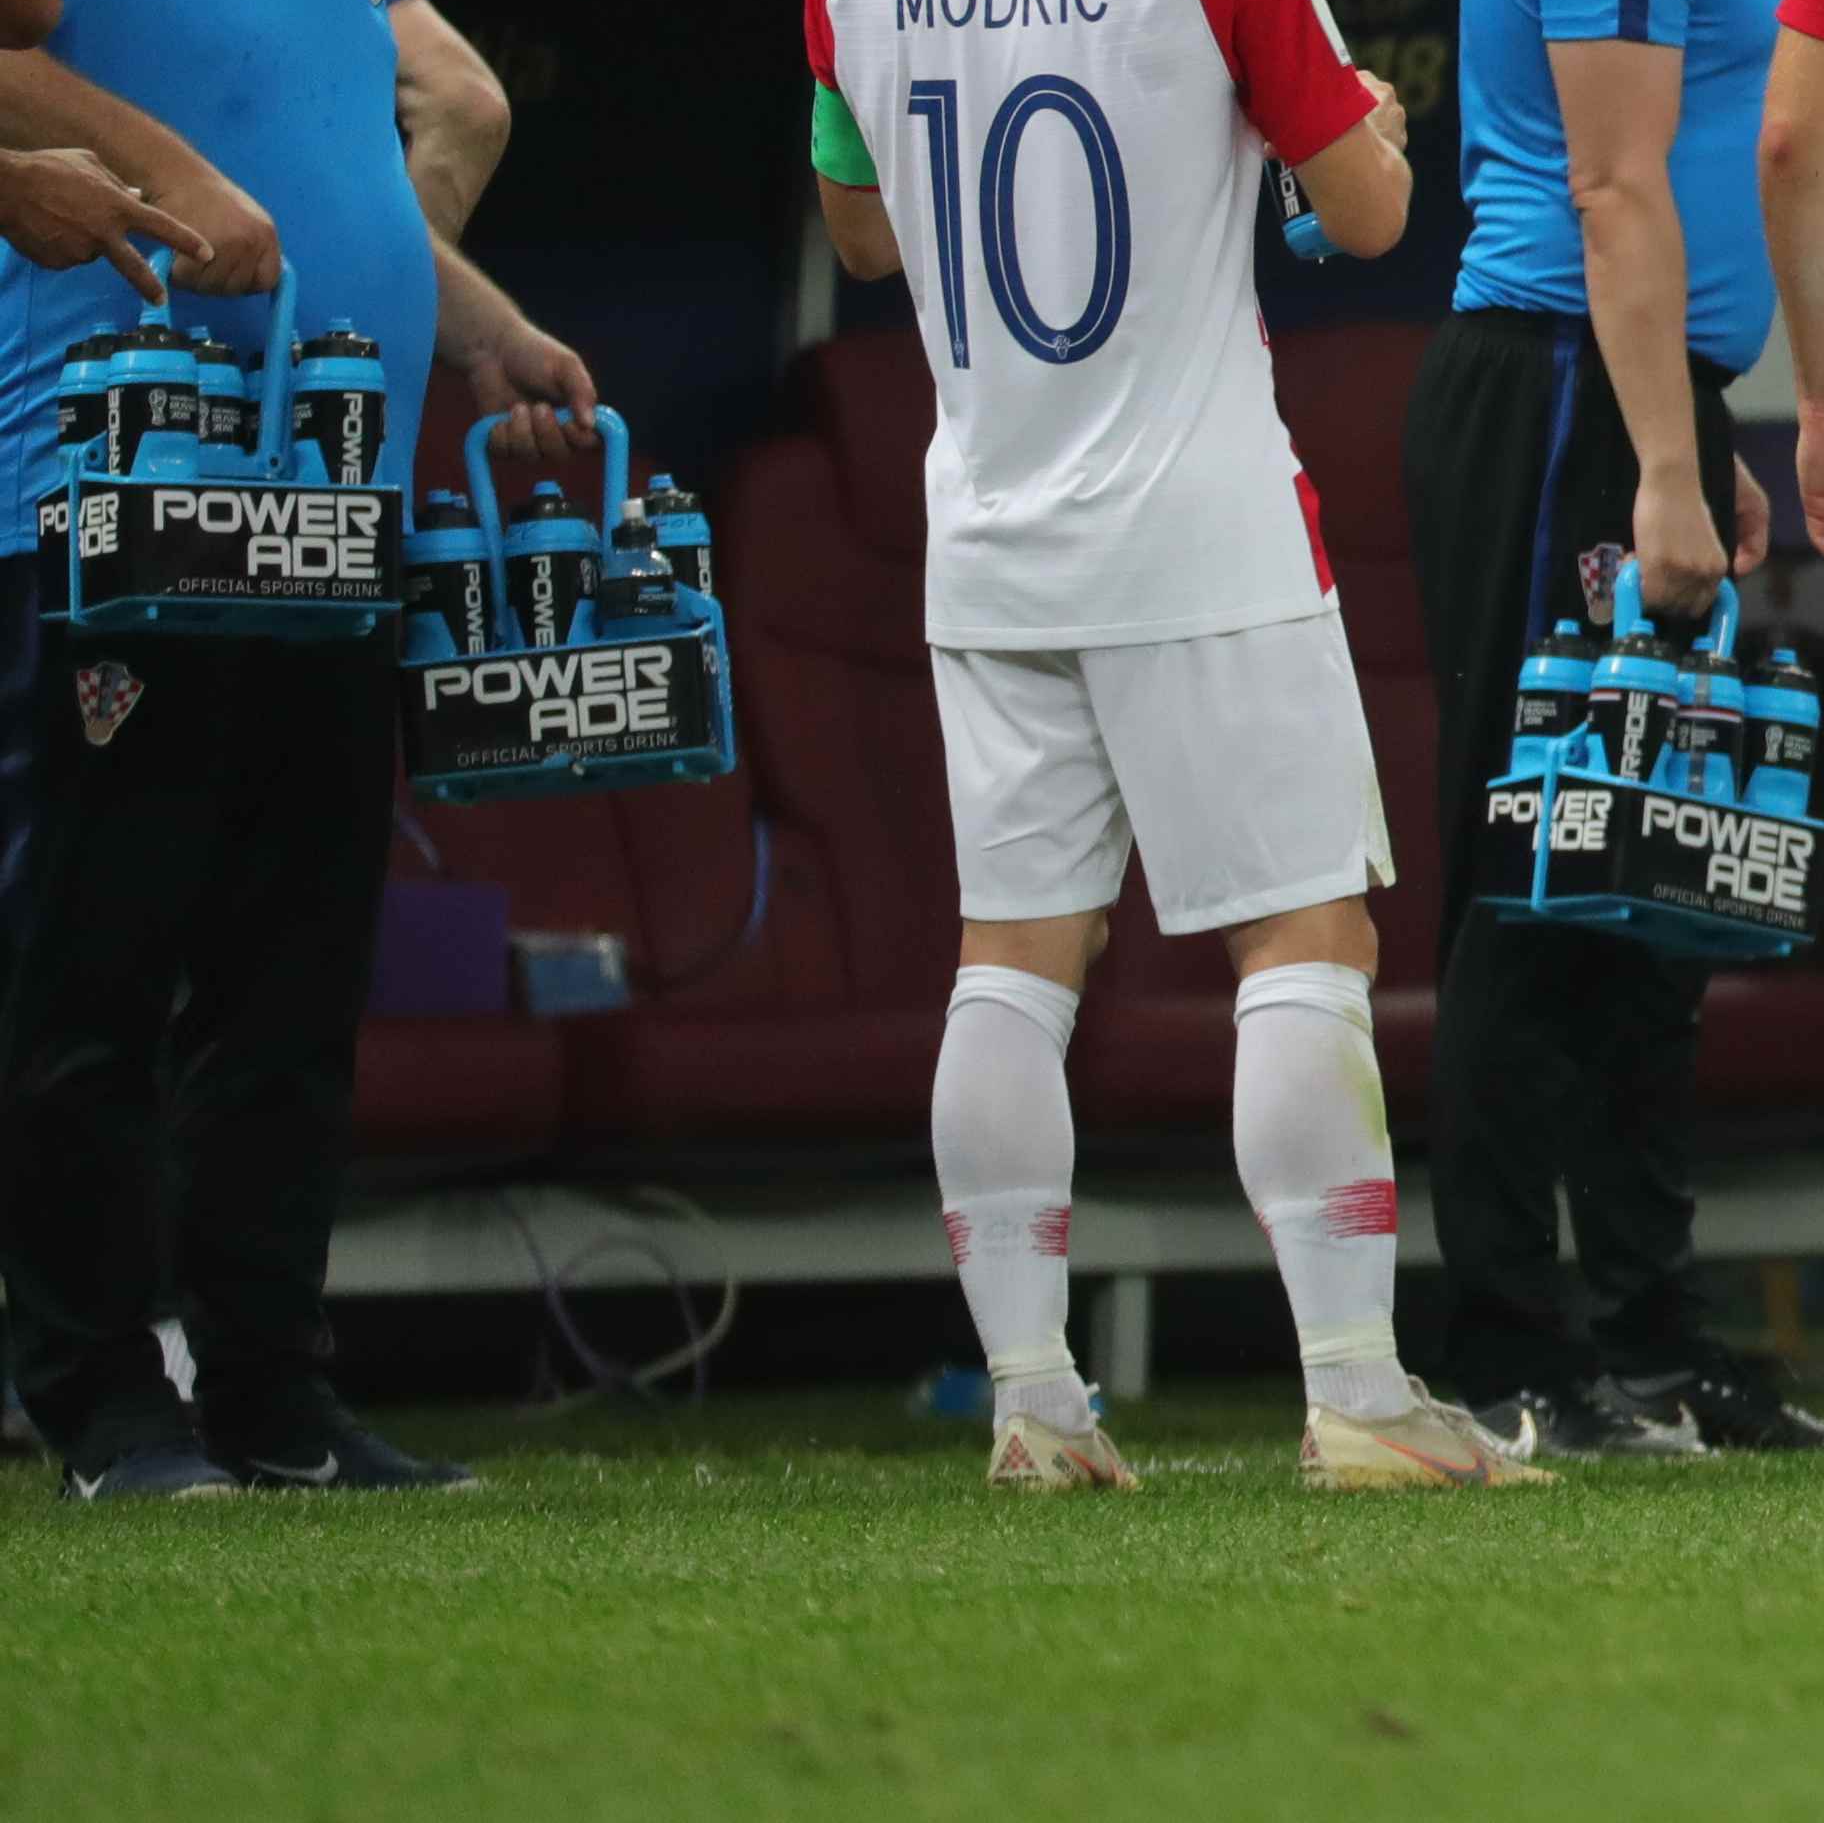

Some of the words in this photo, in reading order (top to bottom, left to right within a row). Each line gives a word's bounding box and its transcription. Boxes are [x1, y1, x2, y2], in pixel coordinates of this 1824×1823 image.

[906, 73, 1132, 370] 10
[342, 392, 363, 485] POWE
[153, 489, 383, 536] POWER
[247, 534, 377, 580] ADE
[178, 577, 254, 594] OFFICIAL
[260, 579, 326, 596] SPORTS
[331, 582, 384, 598] DRINK
[463, 561, 486, 657] POWE
[530, 555, 556, 649] POWE
[423, 644, 673, 711] POWER
[529, 687, 670, 743] ADE
[457, 747, 540, 768] OFFICIAL
[545, 739, 618, 761] SPORTS
[623, 731, 679, 752] DRINK
[1641, 794, 1815, 872] POWER
[1652, 882, 1710, 910] OFFICIAL
[1713, 899, 1763, 921] SPORTS
[1705, 853, 1807, 912] ADE
